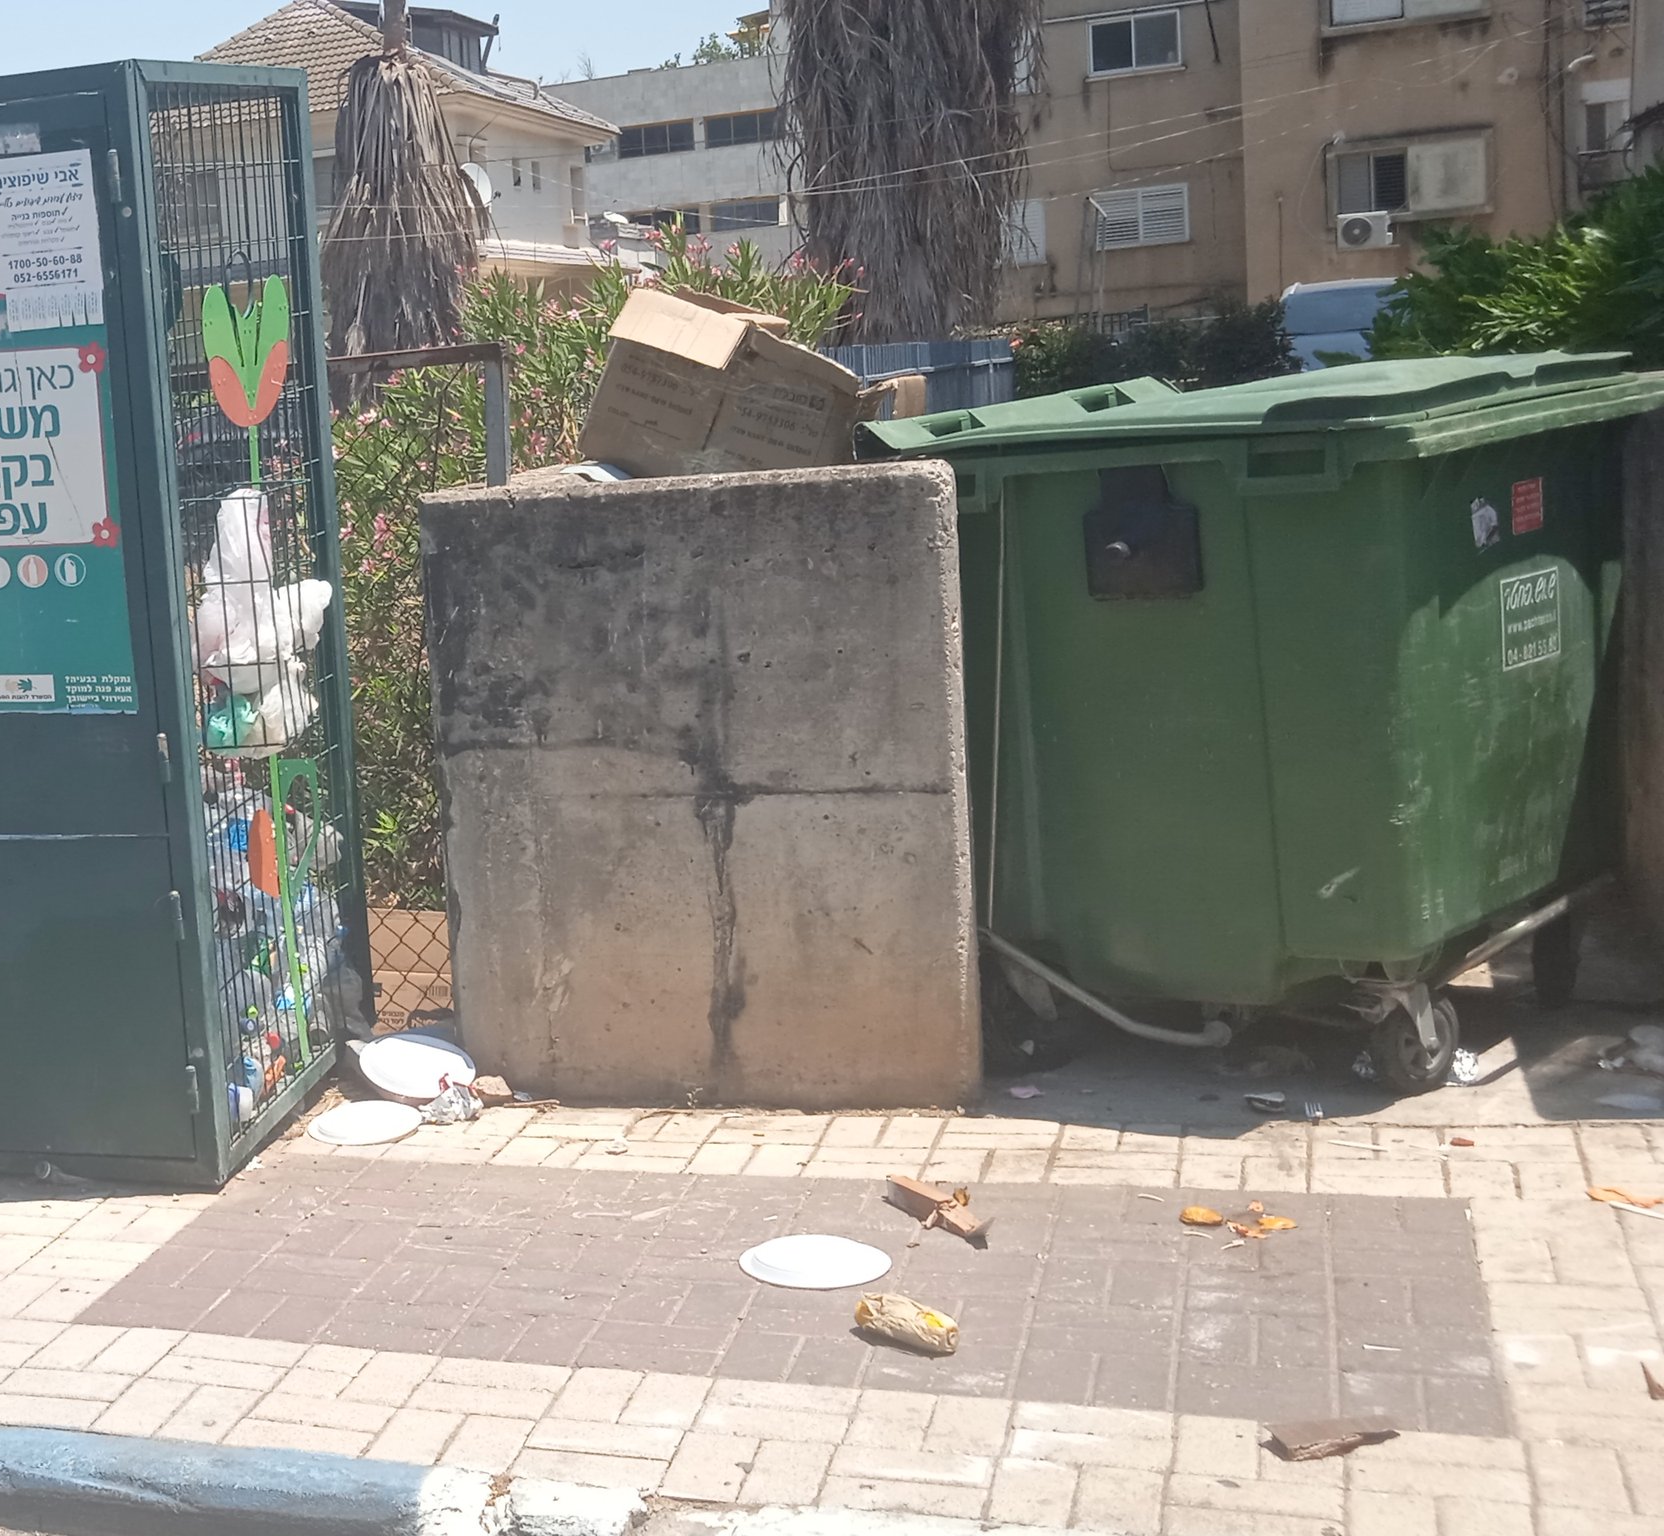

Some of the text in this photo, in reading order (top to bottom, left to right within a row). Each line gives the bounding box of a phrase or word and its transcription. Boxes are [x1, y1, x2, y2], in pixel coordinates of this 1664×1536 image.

[54, 169, 80, 182] אבי
[11, 209, 60, 221] תוספות בנייה
[8, 254, 83, 269] 1700-50-60-88
[13, 268, 78, 283] 052-6556171
[26, 364, 75, 400] כאן
[65, 674, 131, 685] נתקלת בבעיה?
[65, 685, 93, 694] למוקד
[101, 695, 132, 703] העירוני
